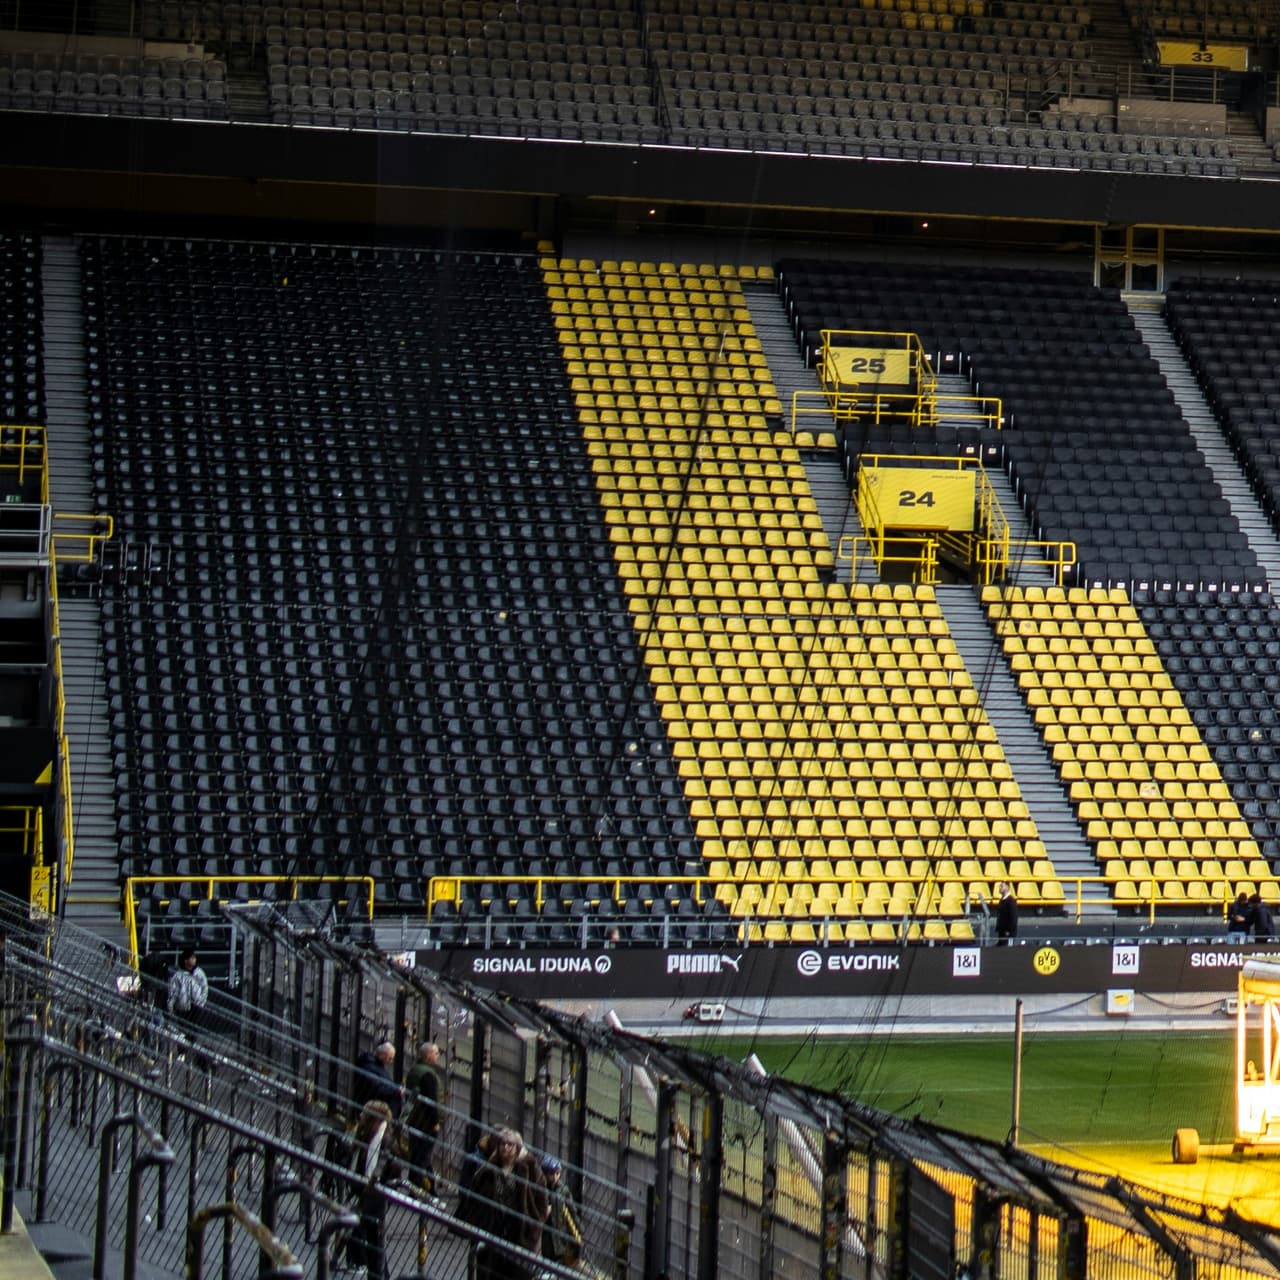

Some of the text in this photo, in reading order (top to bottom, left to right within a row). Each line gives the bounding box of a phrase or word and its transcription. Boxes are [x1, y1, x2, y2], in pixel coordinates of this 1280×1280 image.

[1191, 52, 1213, 63] 33
[851, 357, 886, 374] 25
[898, 490, 936, 507] 24
[473, 957, 593, 973] SIGNAL IDUNA
[667, 954, 721, 974] PUMA
[827, 954, 900, 970] EVONIK
[956, 954, 977, 968] 1&1
[1038, 951, 1056, 966] BVB
[1116, 952, 1136, 967] 1&1
